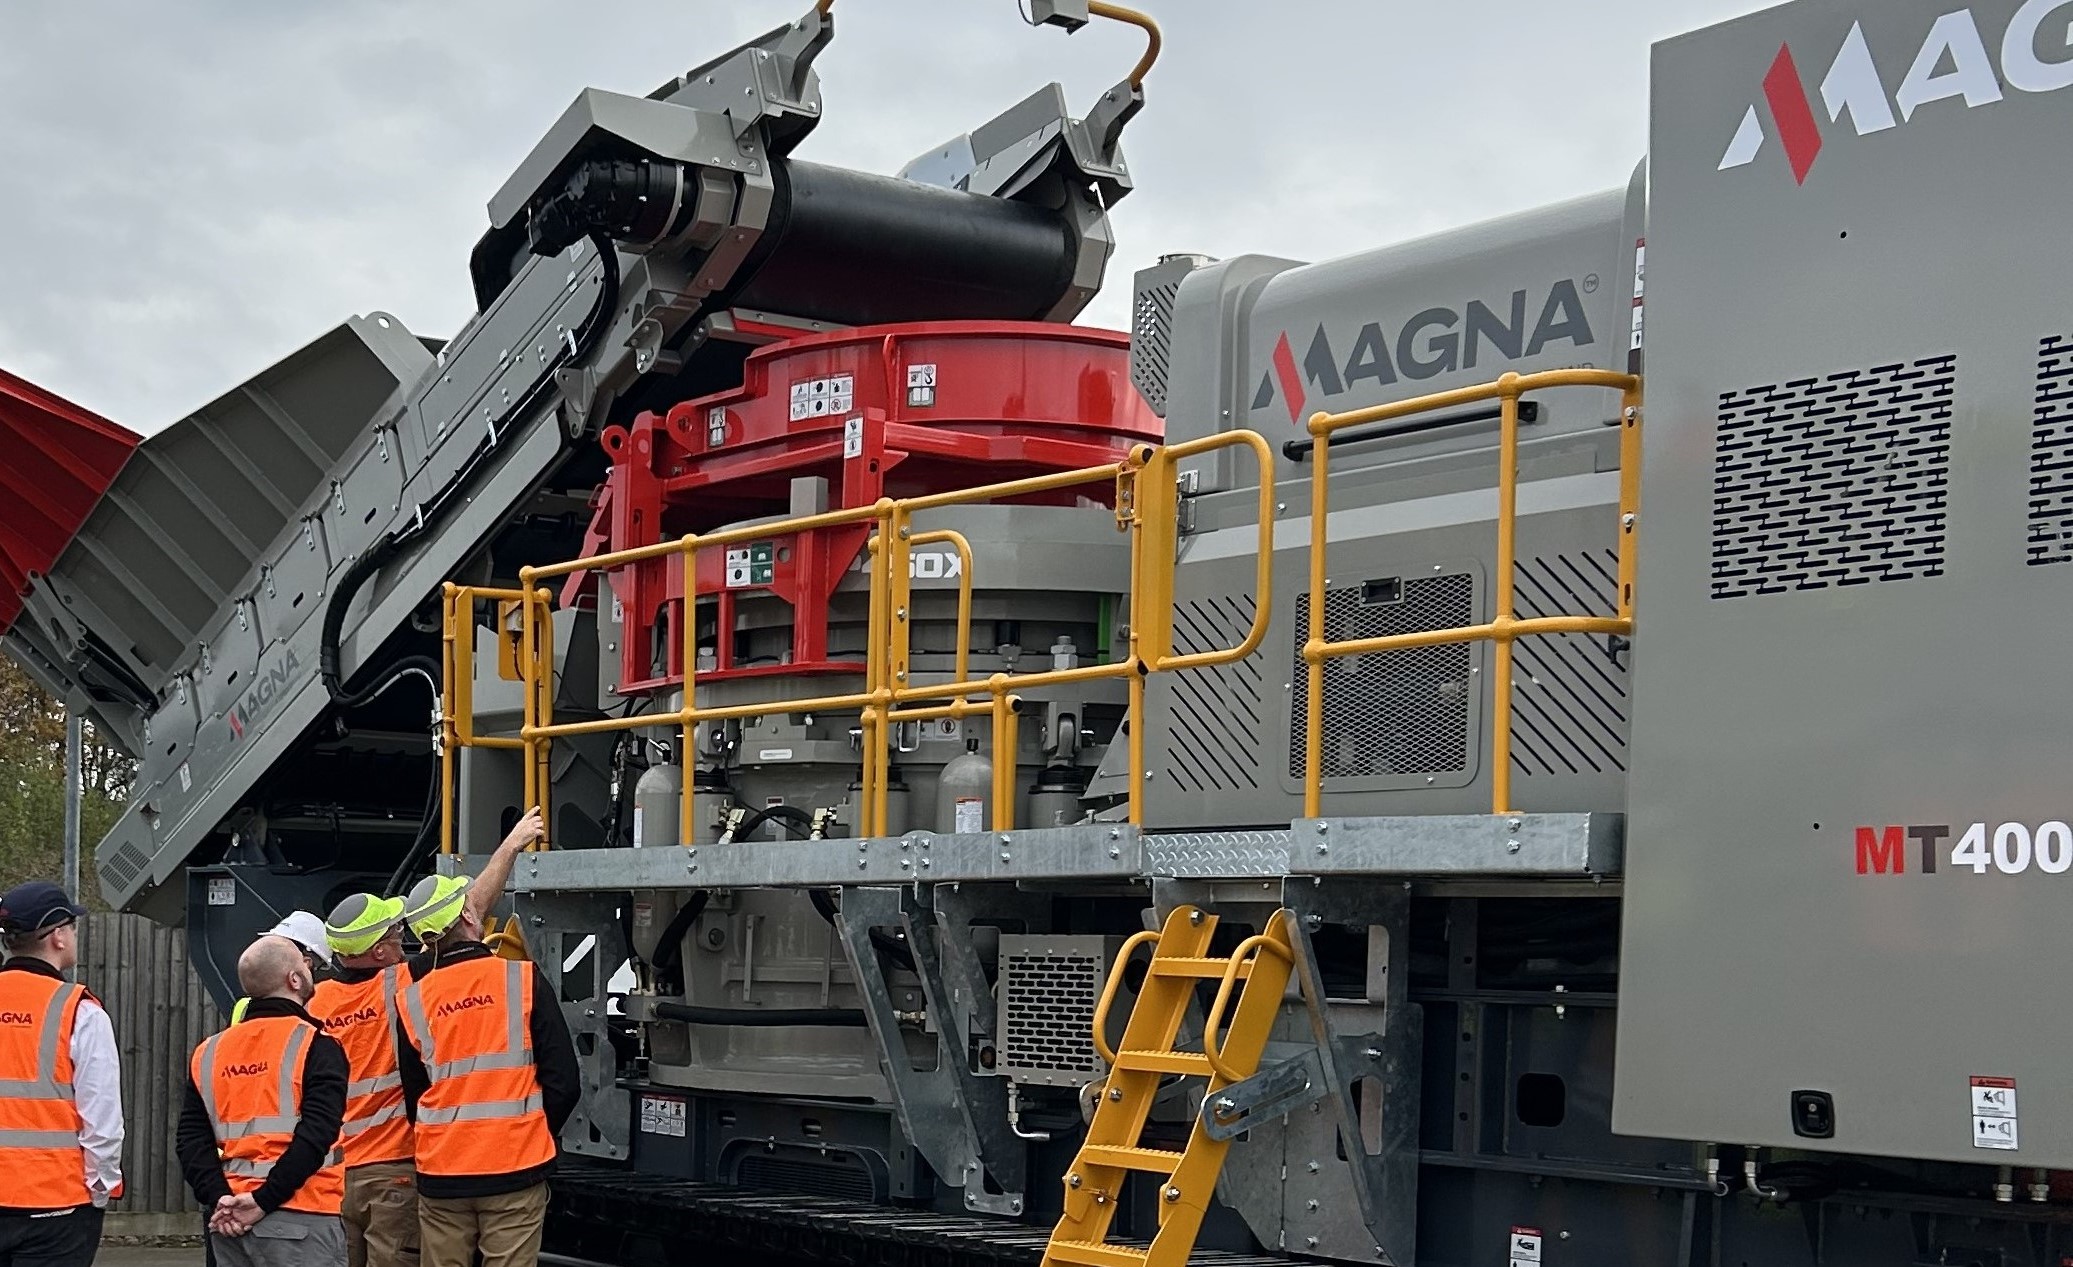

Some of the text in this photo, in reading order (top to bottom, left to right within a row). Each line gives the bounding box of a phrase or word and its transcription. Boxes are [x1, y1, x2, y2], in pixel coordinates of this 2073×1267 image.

[1251, 278, 1594, 426] MAGNA
[228, 648, 300, 742] MAGNA
[1856, 821, 2073, 875] MT400
[437, 995, 494, 1018] MAGNA
